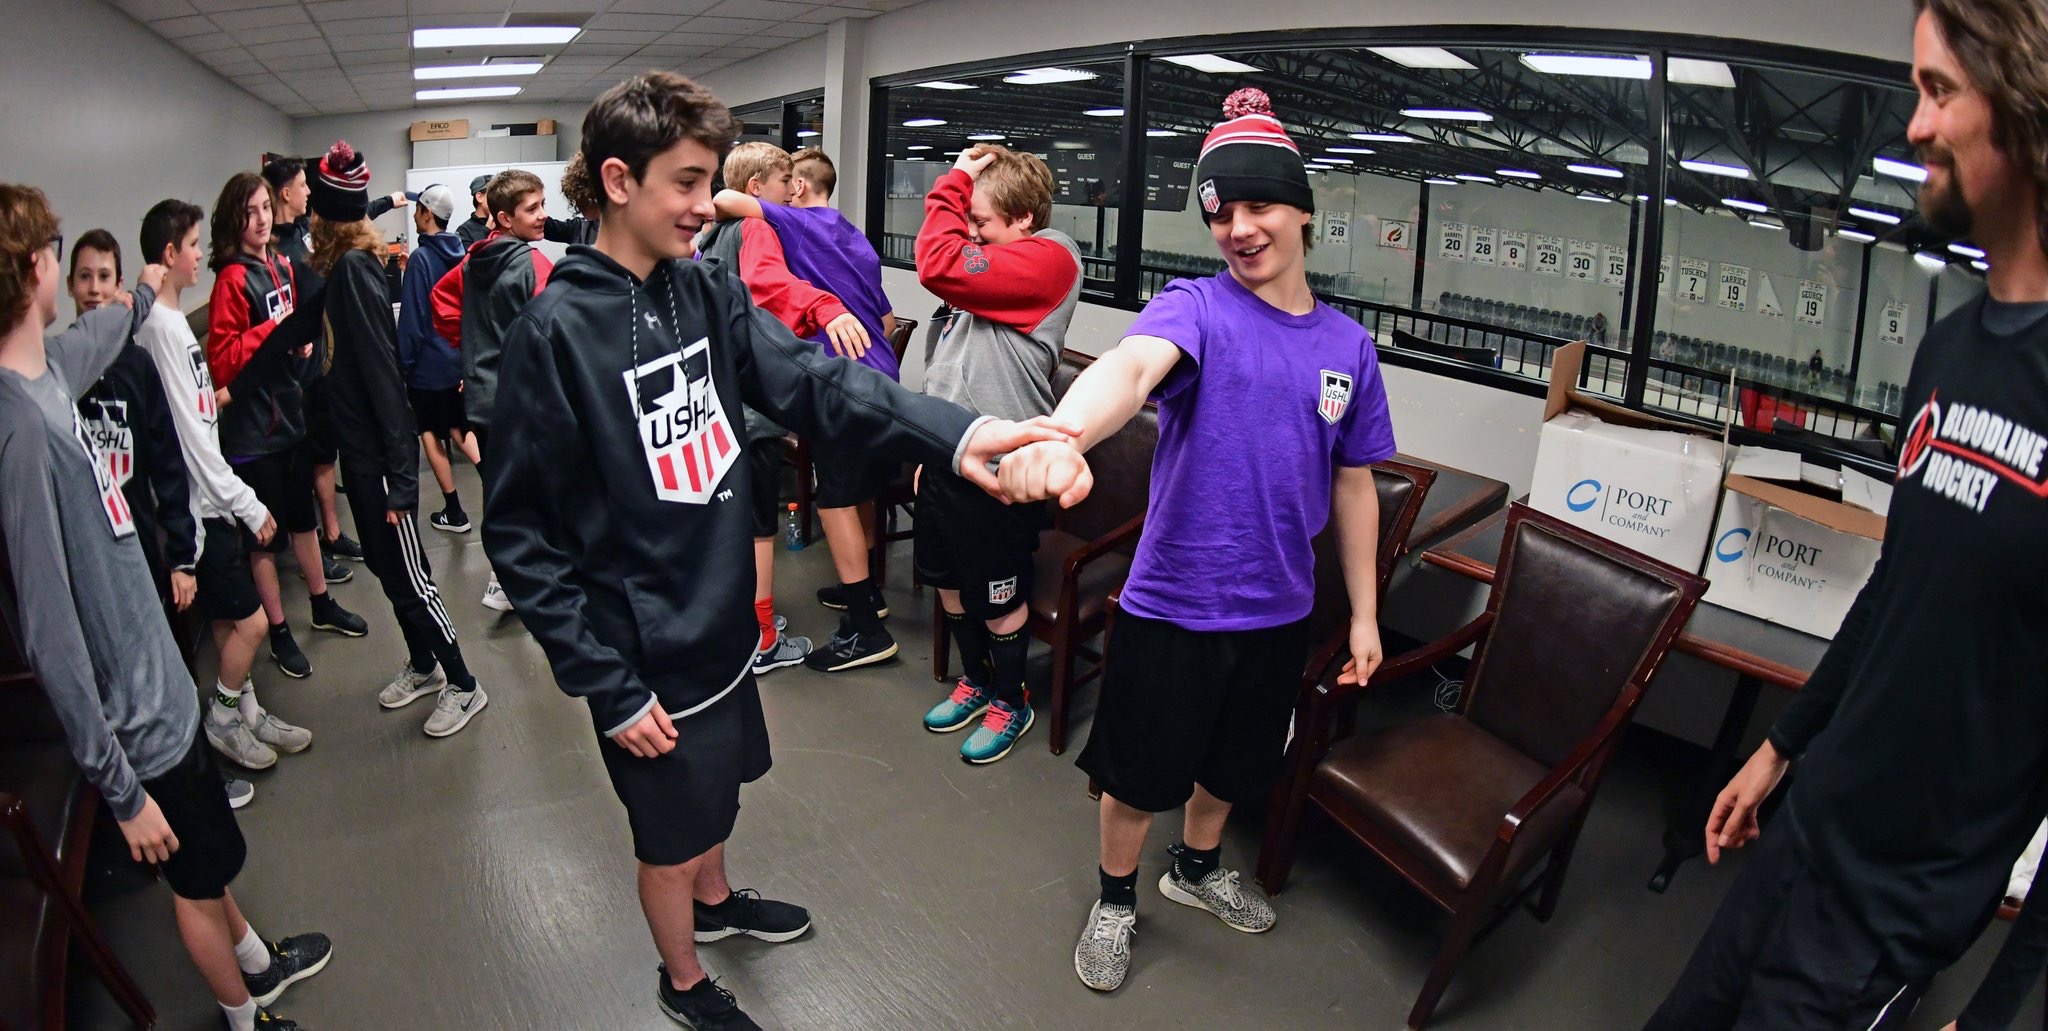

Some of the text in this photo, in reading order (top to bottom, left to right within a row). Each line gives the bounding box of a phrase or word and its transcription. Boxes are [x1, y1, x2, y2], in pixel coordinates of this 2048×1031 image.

[1172, 161, 1191, 169] GUEST
[1330, 226, 1345, 237] 28
[1445, 239, 1461, 251] 20
[1475, 243, 1491, 255] 28
[1536, 244, 1562, 255] WINKLER
[1509, 247, 1518, 259] 8
[1540, 252, 1557, 265] 29
[1573, 257, 1590, 270] 30
[1609, 263, 1624, 276] 15
[1681, 267, 1707, 279] TUSCHER
[1689, 277, 1698, 292] 7
[1721, 275, 1747, 287] CARRICK
[1727, 285, 1740, 301] 19
[1801, 290, 1824, 302] GEORGE
[1804, 301, 1818, 316] 19
[1889, 320, 1898, 333] 9
[1325, 388, 1348, 403] USHL
[651, 390, 717, 449] USHL
[1940, 401, 2048, 479] BLOODLINE
[1921, 450, 1999, 514] HOCKEY
[717, 488, 733, 502] TM
[1616, 487, 1673, 517] PORT
[1631, 512, 1650, 522] and
[1765, 535, 1823, 567] PORT
[1780, 562, 1799, 572] and
